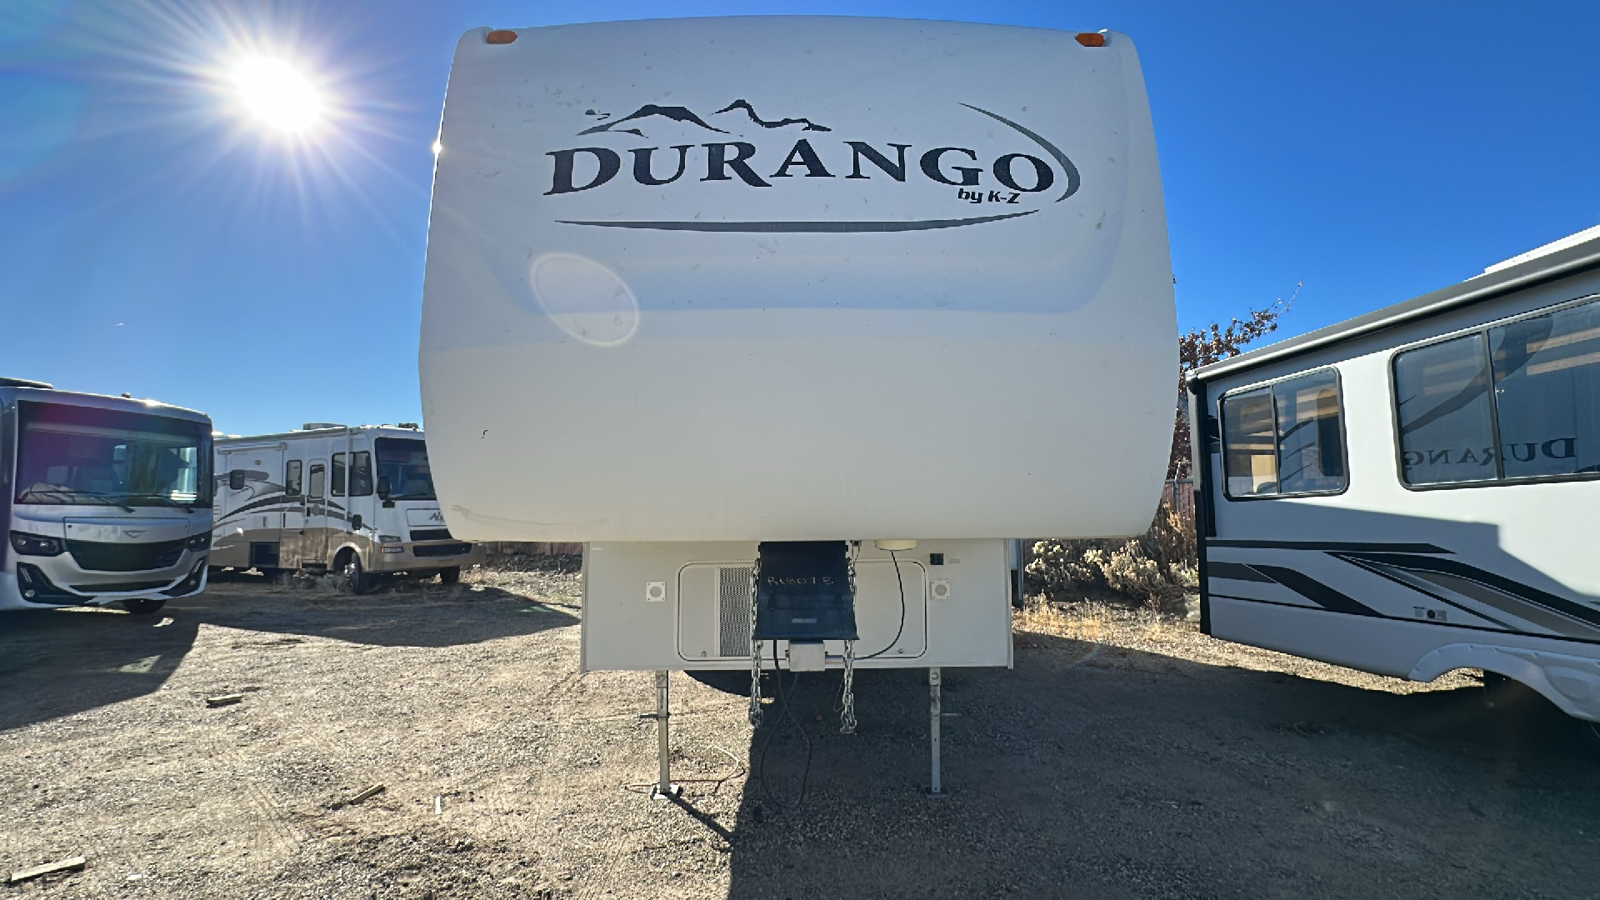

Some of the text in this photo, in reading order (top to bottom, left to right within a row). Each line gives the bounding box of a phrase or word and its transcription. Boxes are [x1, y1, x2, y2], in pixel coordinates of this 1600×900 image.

[543, 138, 1054, 196] DURANGO
[958, 187, 1021, 204] by K-Z
